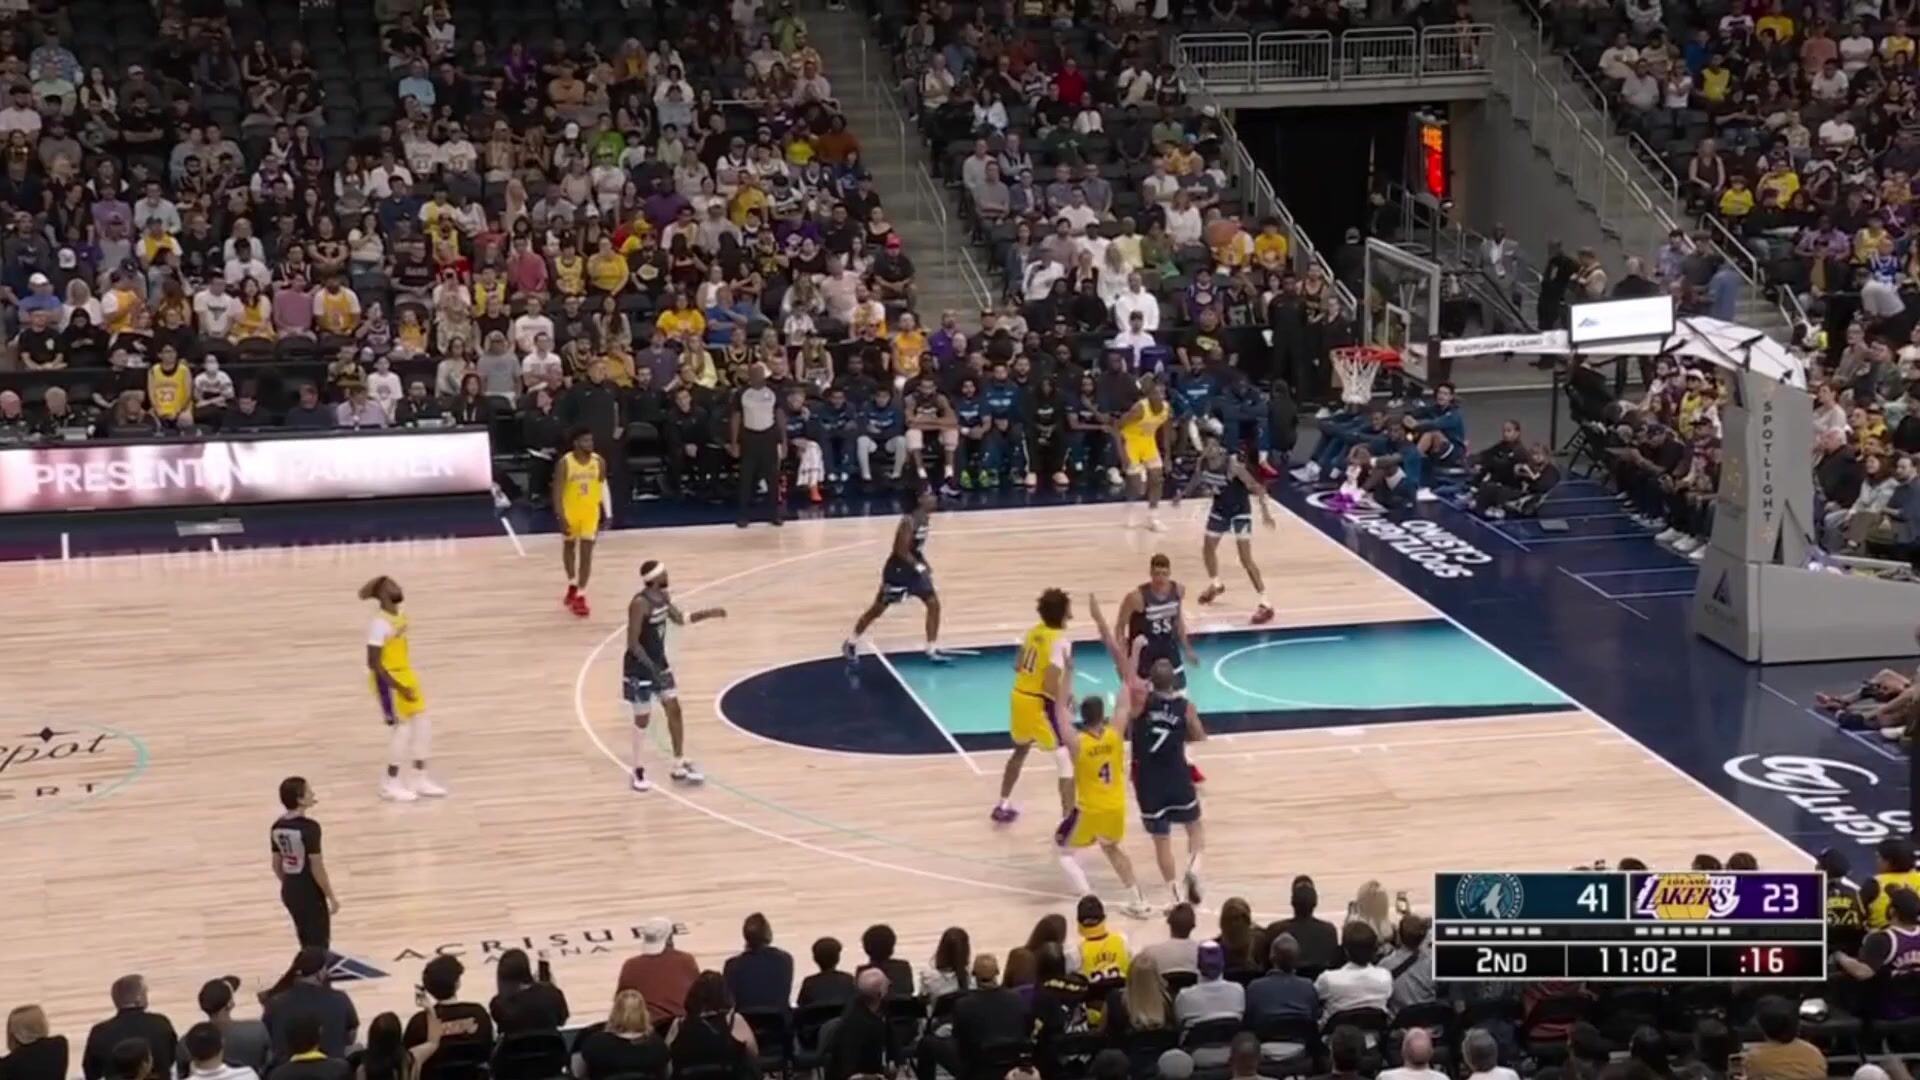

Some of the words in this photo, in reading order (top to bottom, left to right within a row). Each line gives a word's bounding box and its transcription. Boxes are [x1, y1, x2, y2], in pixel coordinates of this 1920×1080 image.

[31, 453, 277, 496] PRESENTN
[1761, 401, 1774, 522] SPOTLIGHT
[1152, 618, 1172, 635] 55
[0, 733, 112, 772] pot
[1148, 727, 1171, 753] 7
[1098, 762, 1113, 785] 4
[484, 946, 611, 964] AENA
